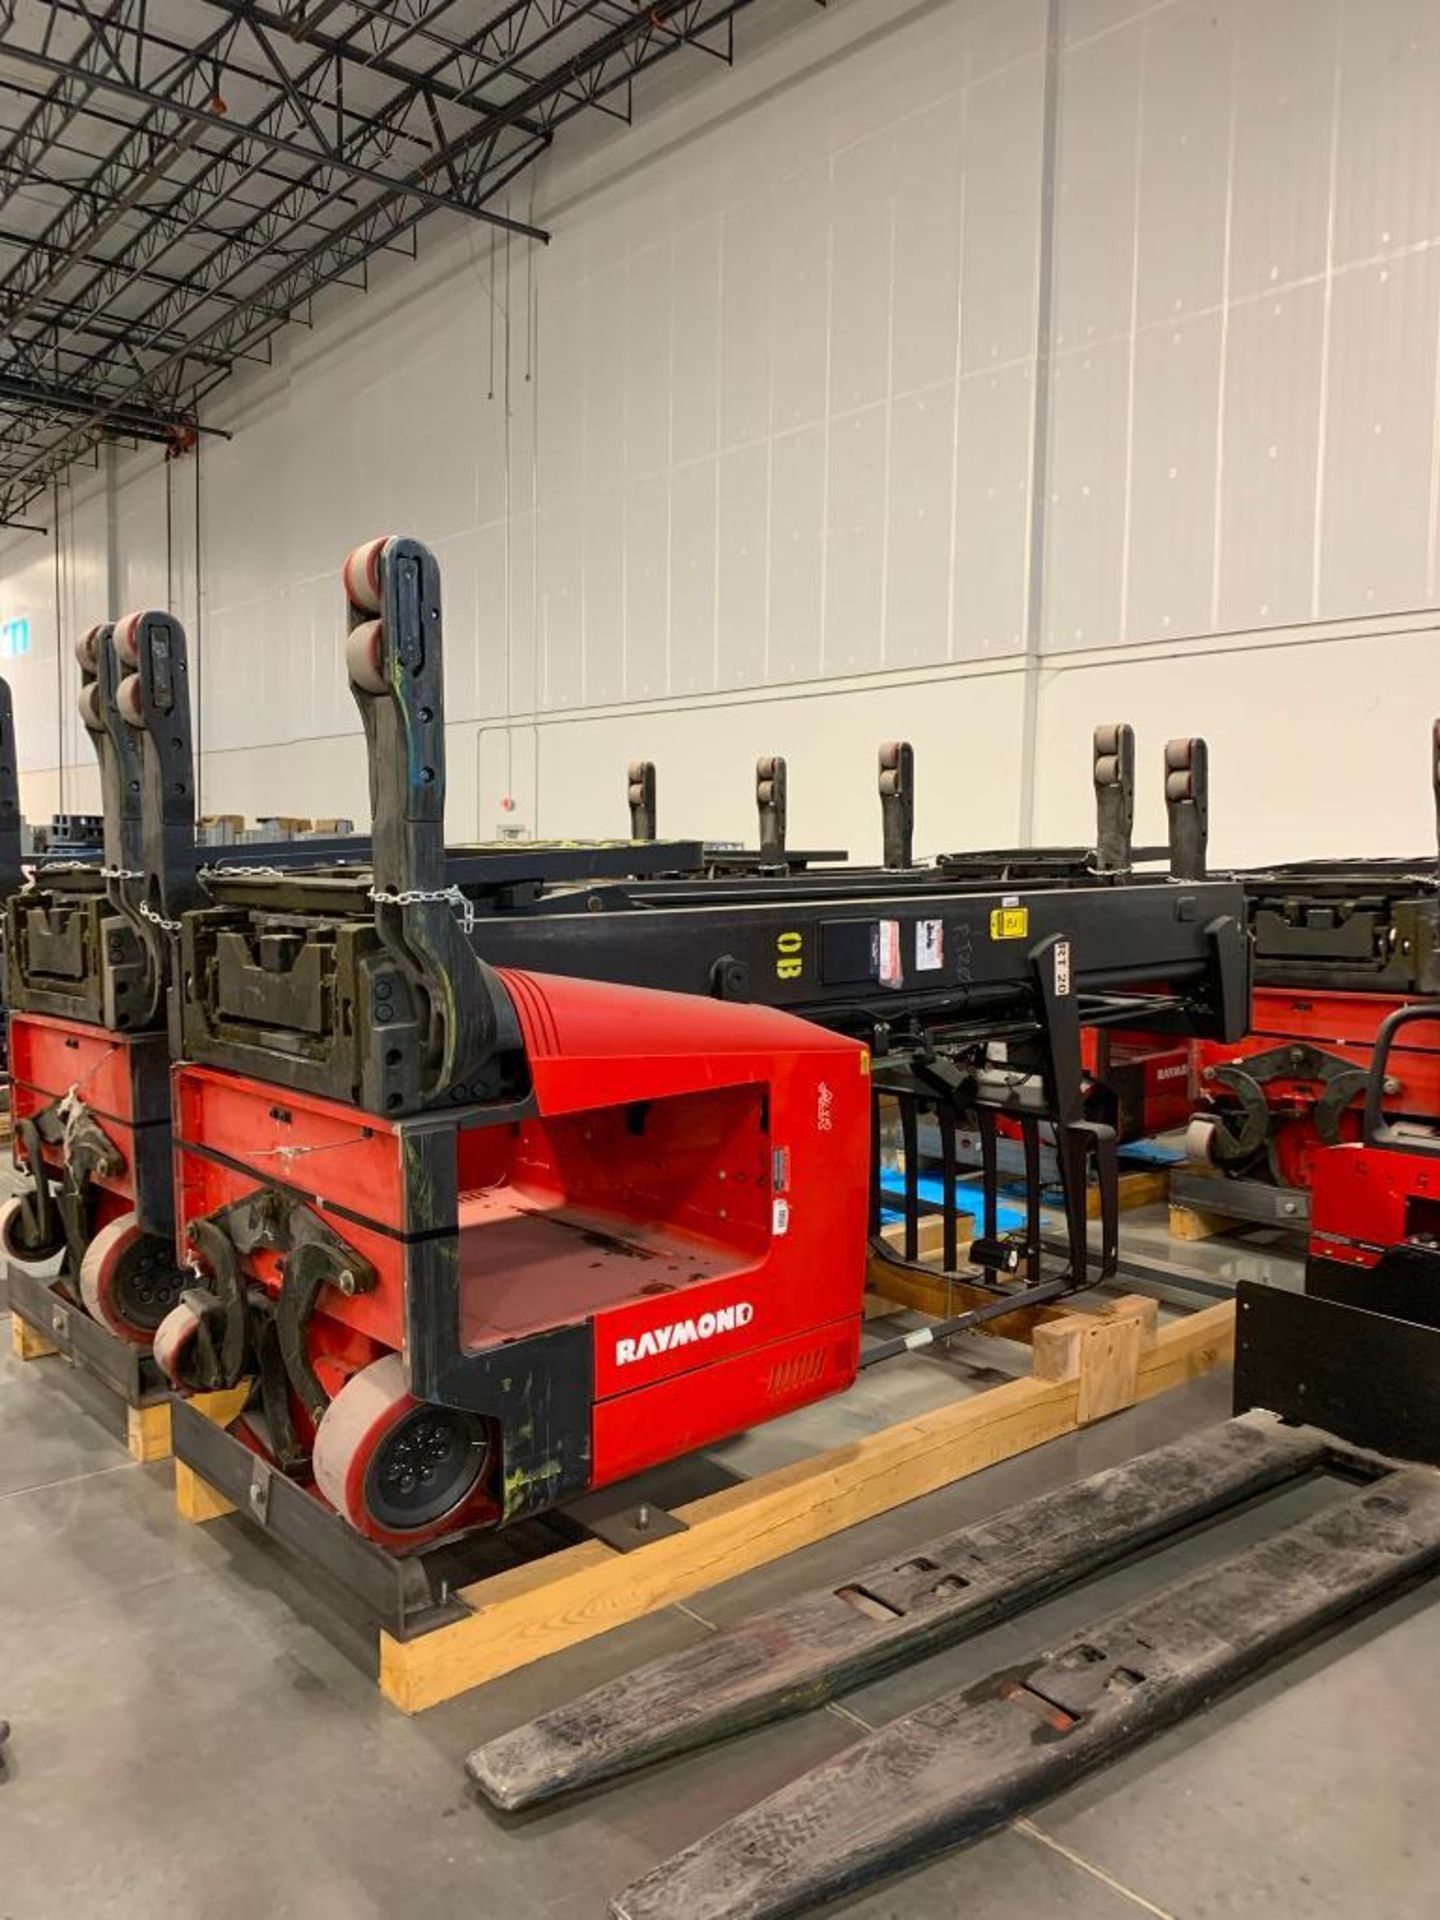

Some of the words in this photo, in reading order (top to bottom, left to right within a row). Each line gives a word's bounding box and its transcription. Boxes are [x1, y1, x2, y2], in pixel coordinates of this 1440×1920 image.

[1057, 943, 1066, 966] RT
[1057, 974, 1066, 994] 20
[615, 1302, 754, 1366] RAYMOND
